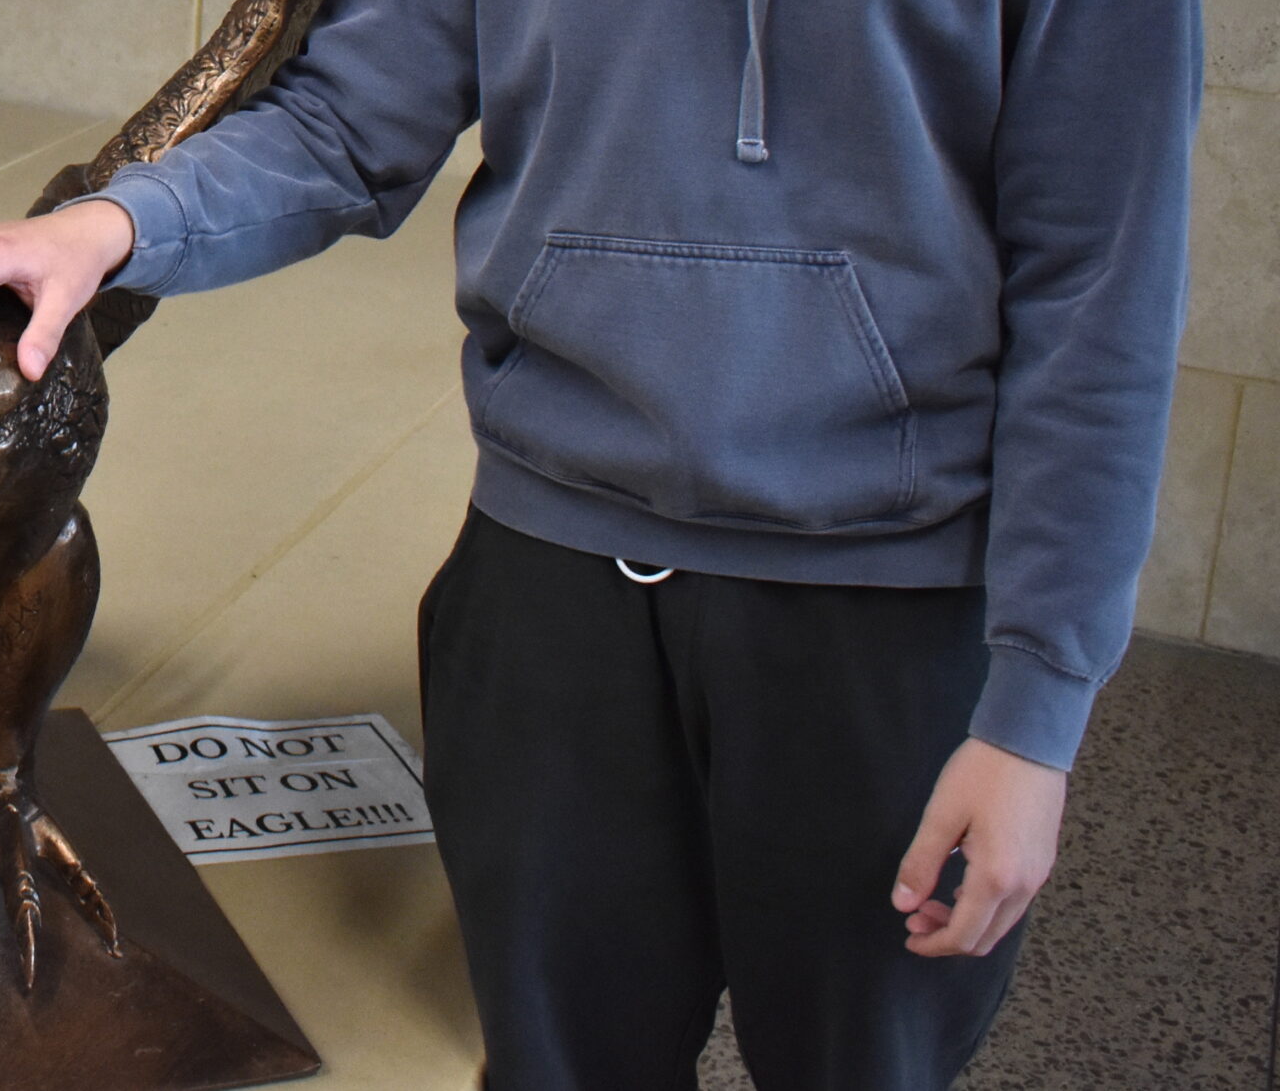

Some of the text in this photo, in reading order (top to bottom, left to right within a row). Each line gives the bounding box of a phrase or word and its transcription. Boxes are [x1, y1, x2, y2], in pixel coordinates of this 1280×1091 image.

[148, 734, 344, 764] DO NOT
[188, 769, 358, 799] SIT ON
[184, 803, 413, 841] EAGLE!!!!
